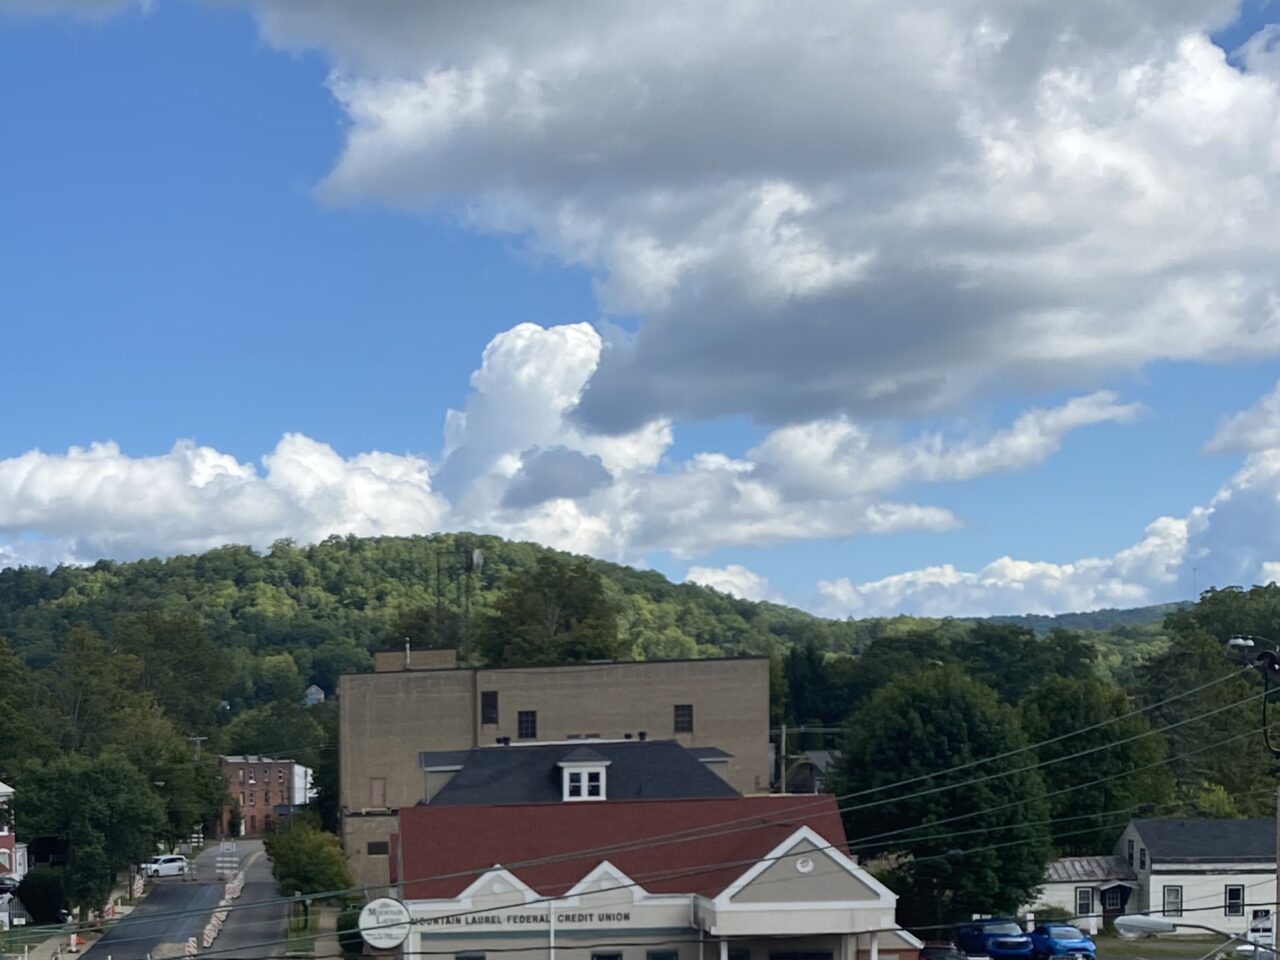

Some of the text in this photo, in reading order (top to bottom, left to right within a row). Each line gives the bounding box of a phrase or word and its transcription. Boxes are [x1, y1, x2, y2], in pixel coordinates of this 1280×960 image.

[465, 915, 502, 925] LAUREL
[507, 914, 550, 924] FEDERAL
[557, 914, 594, 922] CREDIT
[598, 912, 630, 921] UNION
